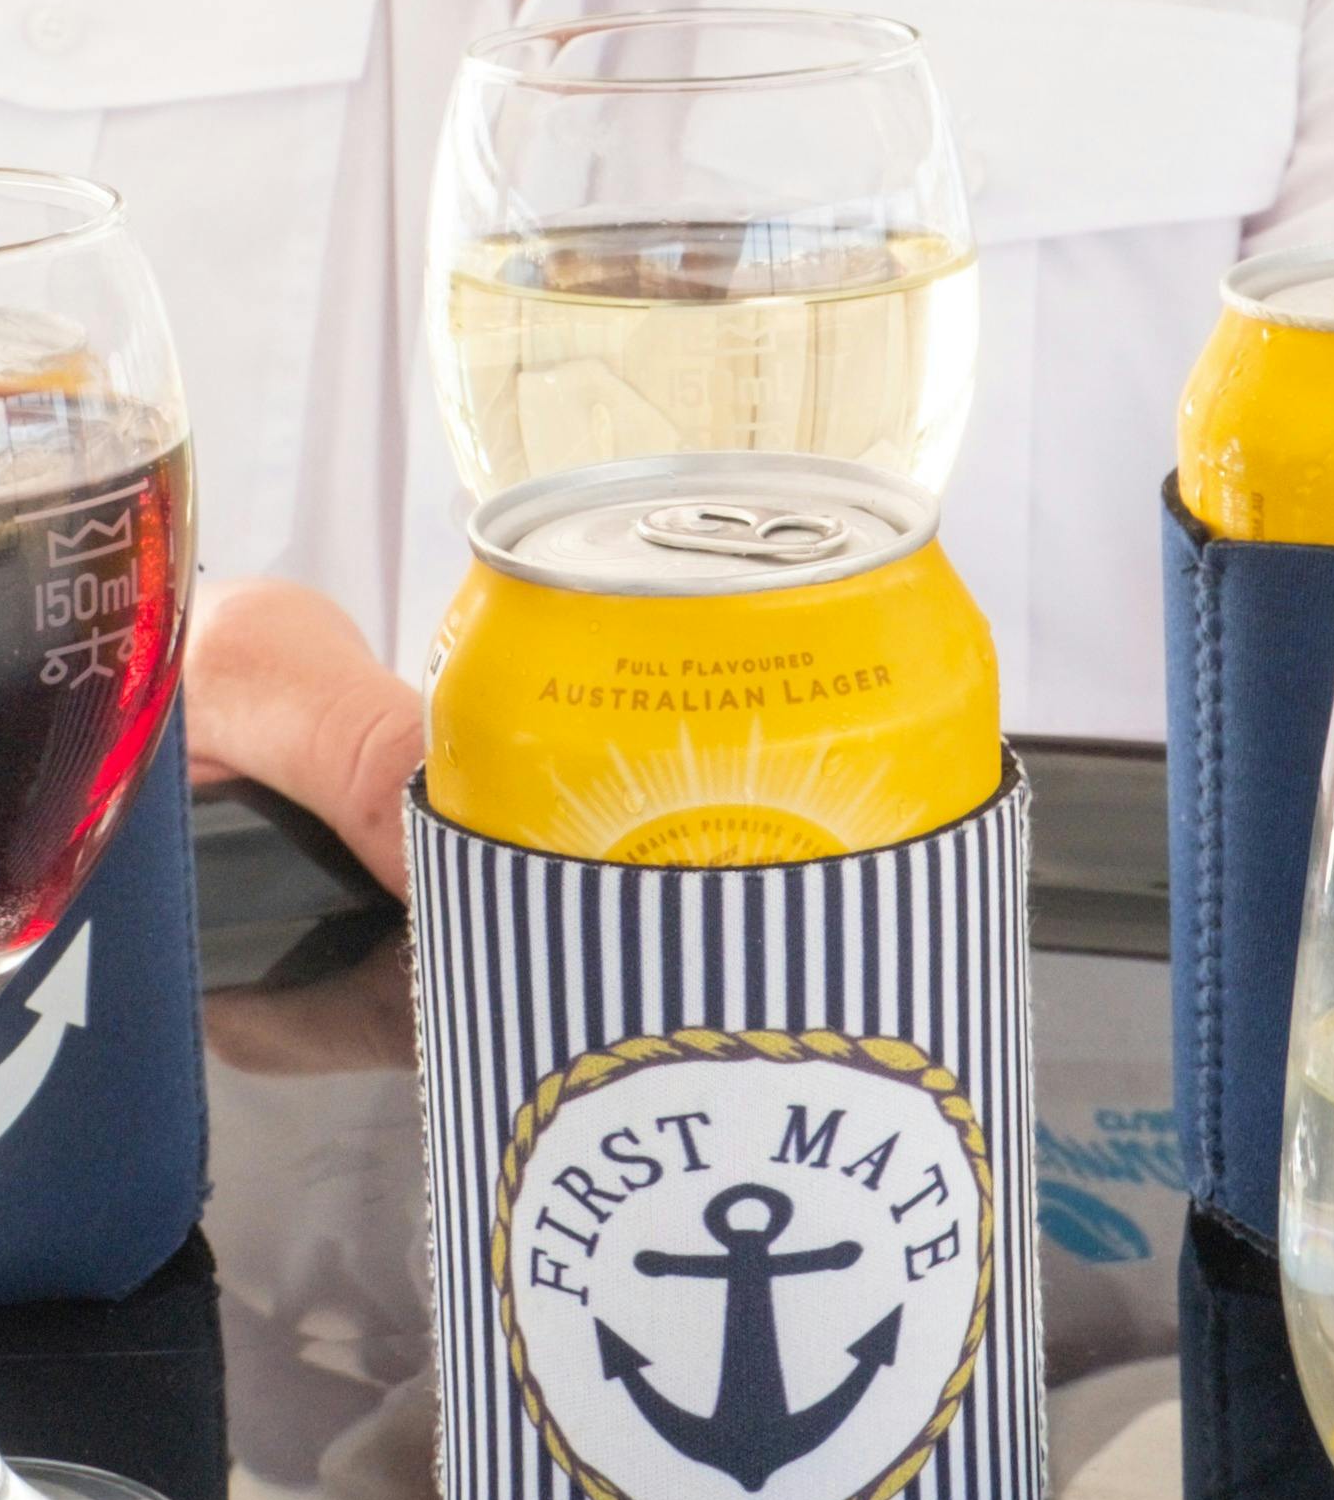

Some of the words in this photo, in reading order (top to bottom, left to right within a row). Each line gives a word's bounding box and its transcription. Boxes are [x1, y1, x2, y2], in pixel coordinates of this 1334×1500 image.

[538, 677, 766, 712] AUSTRALIAN
[783, 664, 893, 705] LAGER
[616, 657, 669, 677] FULL
[682, 651, 815, 677] FLAVOURED
[530, 1111, 711, 1306] FIRST
[770, 1103, 961, 1283] MATE
